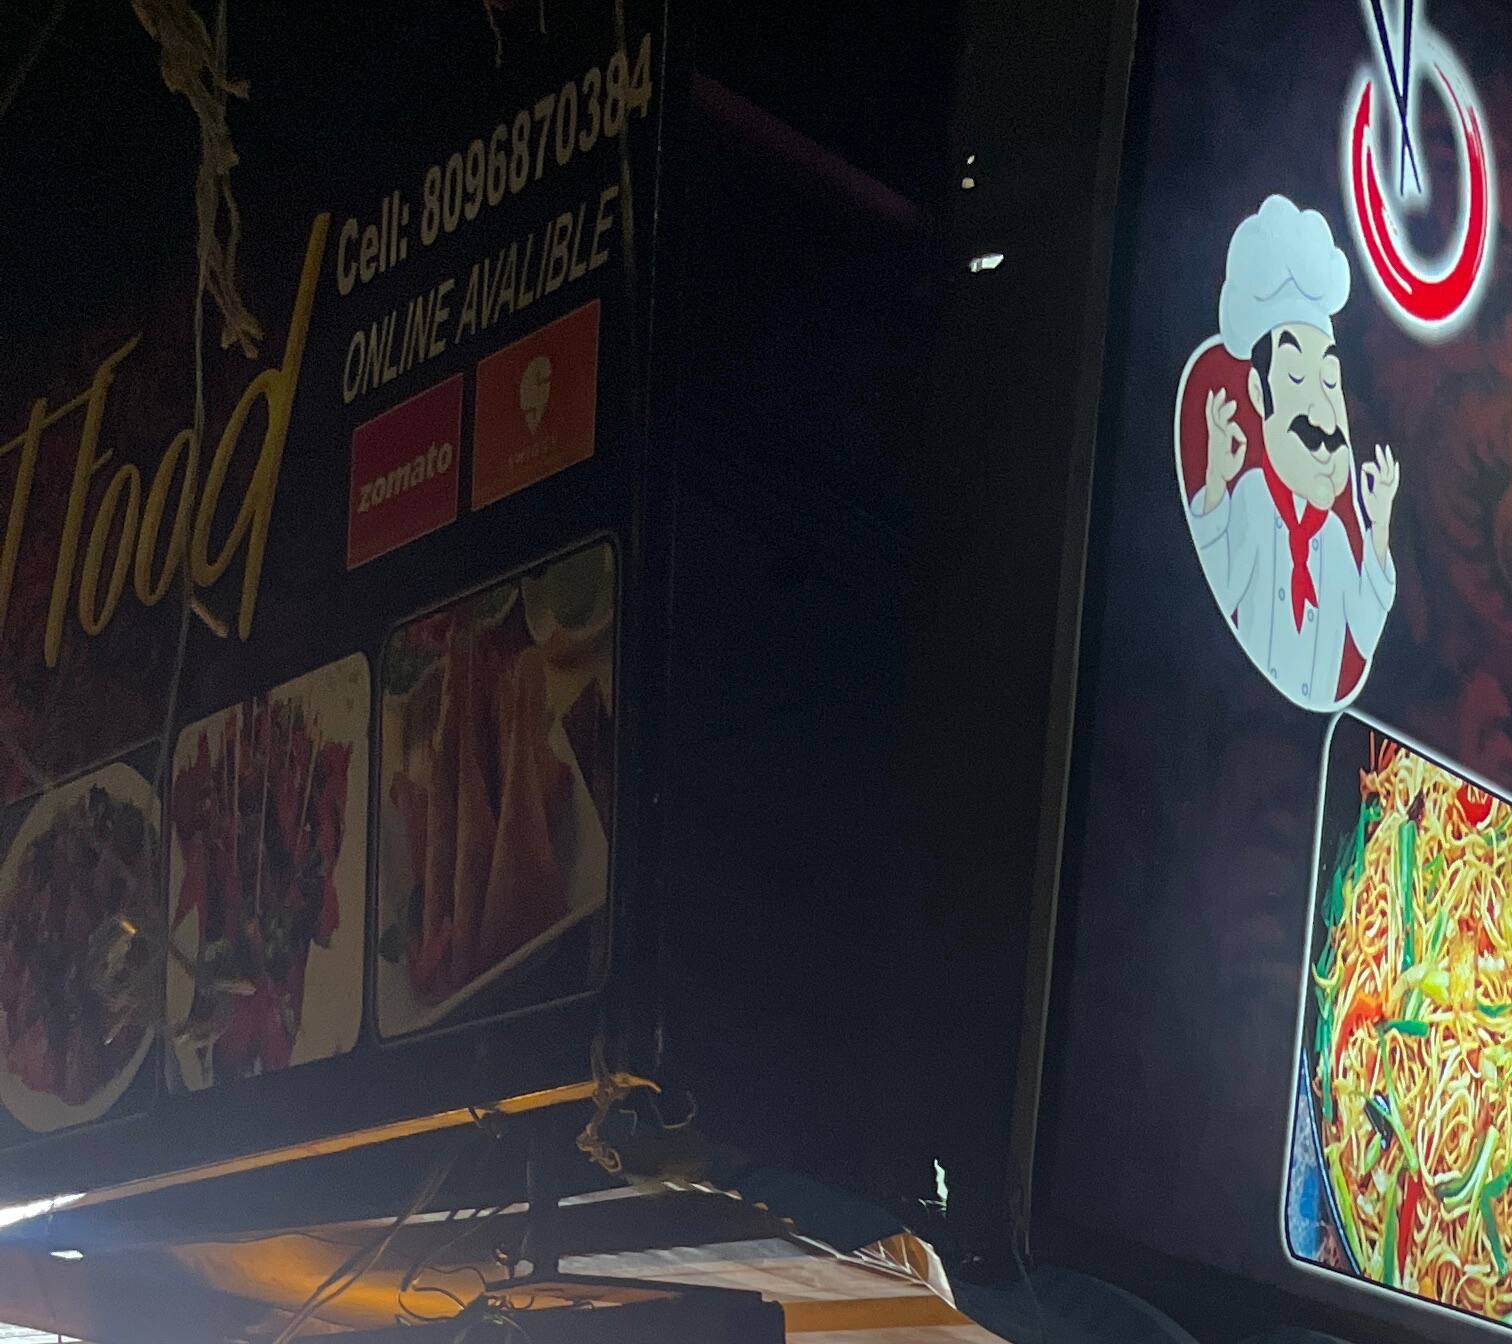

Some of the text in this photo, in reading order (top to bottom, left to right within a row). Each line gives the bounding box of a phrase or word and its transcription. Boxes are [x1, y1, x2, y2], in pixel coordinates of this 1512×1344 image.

[336, 32, 655, 296] Cell: 8096870384
[343, 185, 619, 404] ONLINE AVALIBLE
[44, 212, 331, 668] Food
[357, 441, 453, 513] zomato
